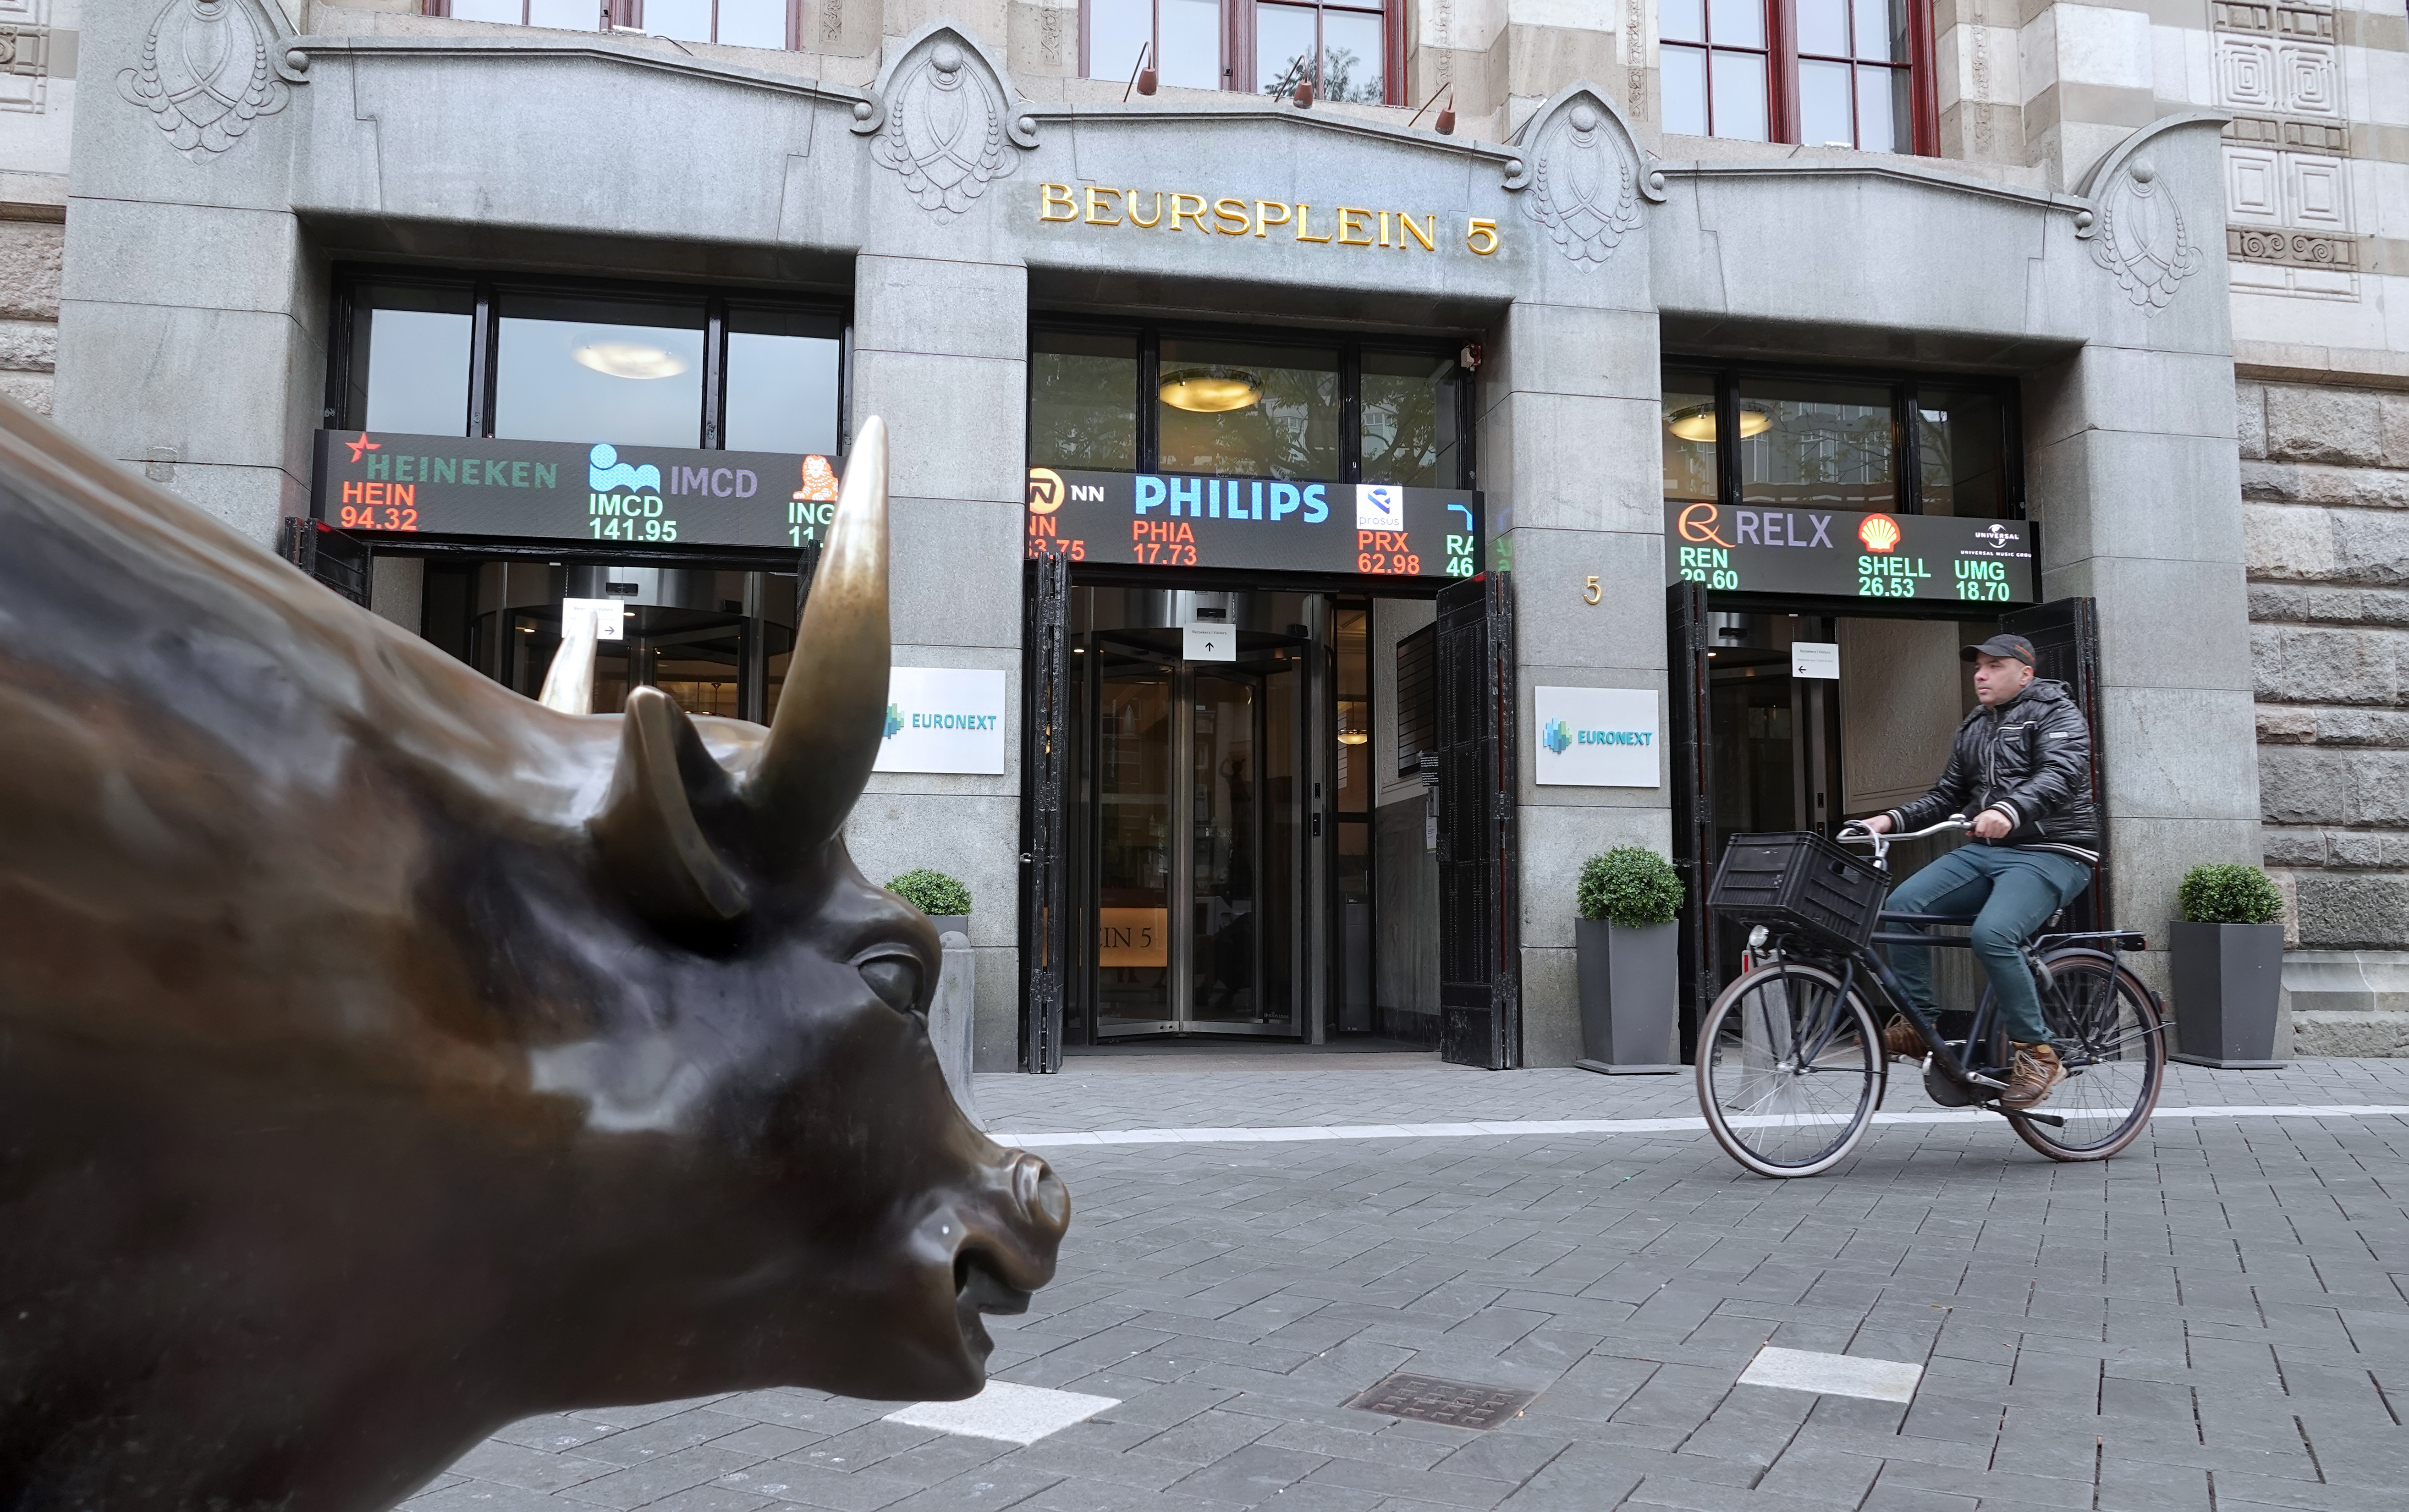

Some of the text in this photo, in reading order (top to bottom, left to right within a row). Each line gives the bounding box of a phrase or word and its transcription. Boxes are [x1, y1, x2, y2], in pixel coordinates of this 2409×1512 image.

[1040, 183, 1498, 255] BEURSPLEIN 5
[367, 453, 557, 489] HEINEKEN
[670, 465, 759, 499] IMCD
[343, 481, 415, 506] HEIN
[1071, 485, 1104, 501] NN
[1135, 475, 1329, 523] PHILIPS
[589, 493, 664, 518] IMCD
[789, 502, 835, 524] ING
[341, 506, 418, 531] 94.32
[589, 517, 677, 542] 141.95
[1359, 517, 1399, 526] prosus
[1736, 511, 1833, 548] RELX
[789, 526, 828, 548] 11.
[1133, 520, 1195, 544] PHIA
[1358, 530, 1409, 552] PRX
[1975, 532, 2019, 540] UNIVERSAL
[1029, 539, 1085, 561] 3.75
[1133, 543, 1197, 566] 17.73
[1680, 546, 1728, 568] REN
[1358, 552, 1420, 575] 62.98
[1446, 556, 1474, 577] 46
[1858, 556, 1931, 579] SHELL
[1954, 560, 2005, 580] UMG
[1584, 575, 1601, 605] 5
[1680, 568, 1738, 590] 29.60
[1859, 577, 1915, 598] 26.53
[1956, 580, 2010, 602] 18.70
[912, 713, 996, 730] EURONEXT
[1578, 730, 1652, 745] EURONEXT
[1100, 926, 1152, 948] IN 5
